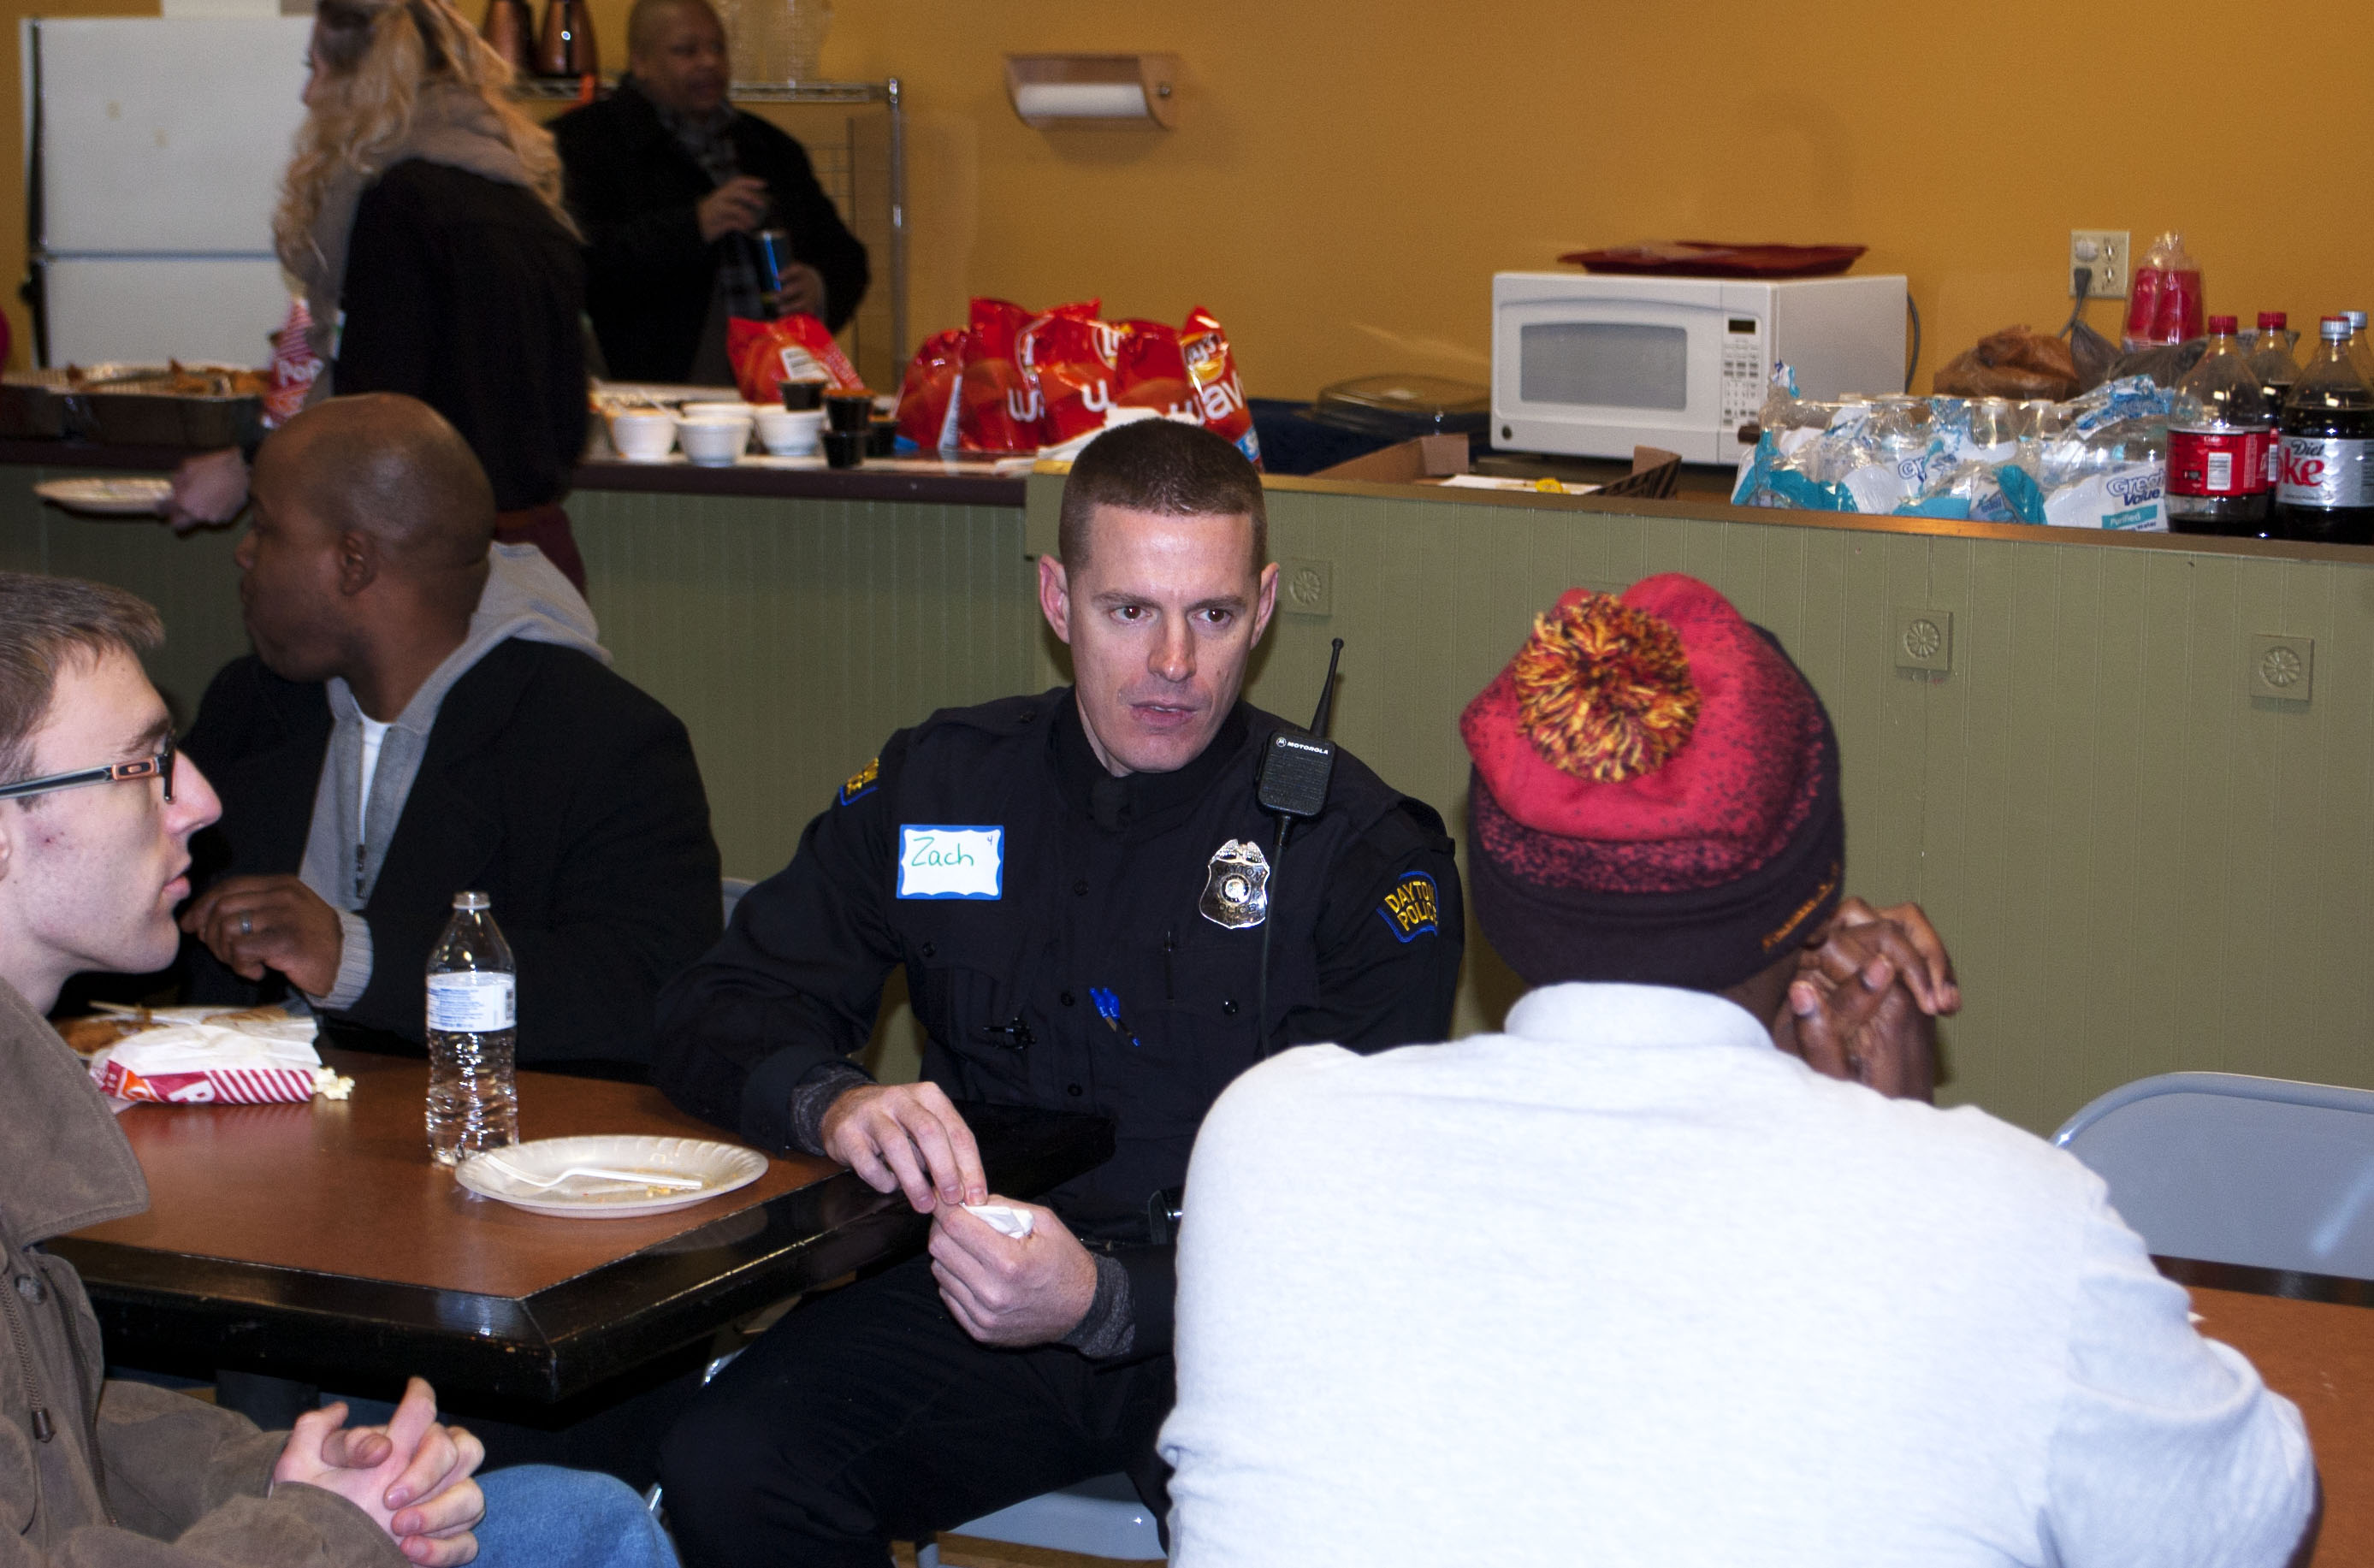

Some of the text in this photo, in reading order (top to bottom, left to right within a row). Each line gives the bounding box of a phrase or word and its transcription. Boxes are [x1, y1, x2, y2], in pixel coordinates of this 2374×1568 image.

[2291, 439, 2325, 456] Diet
[2123, 488, 2160, 506] Value
[1288, 742, 1329, 754] MOTOROLA
[911, 837, 974, 867] Zach
